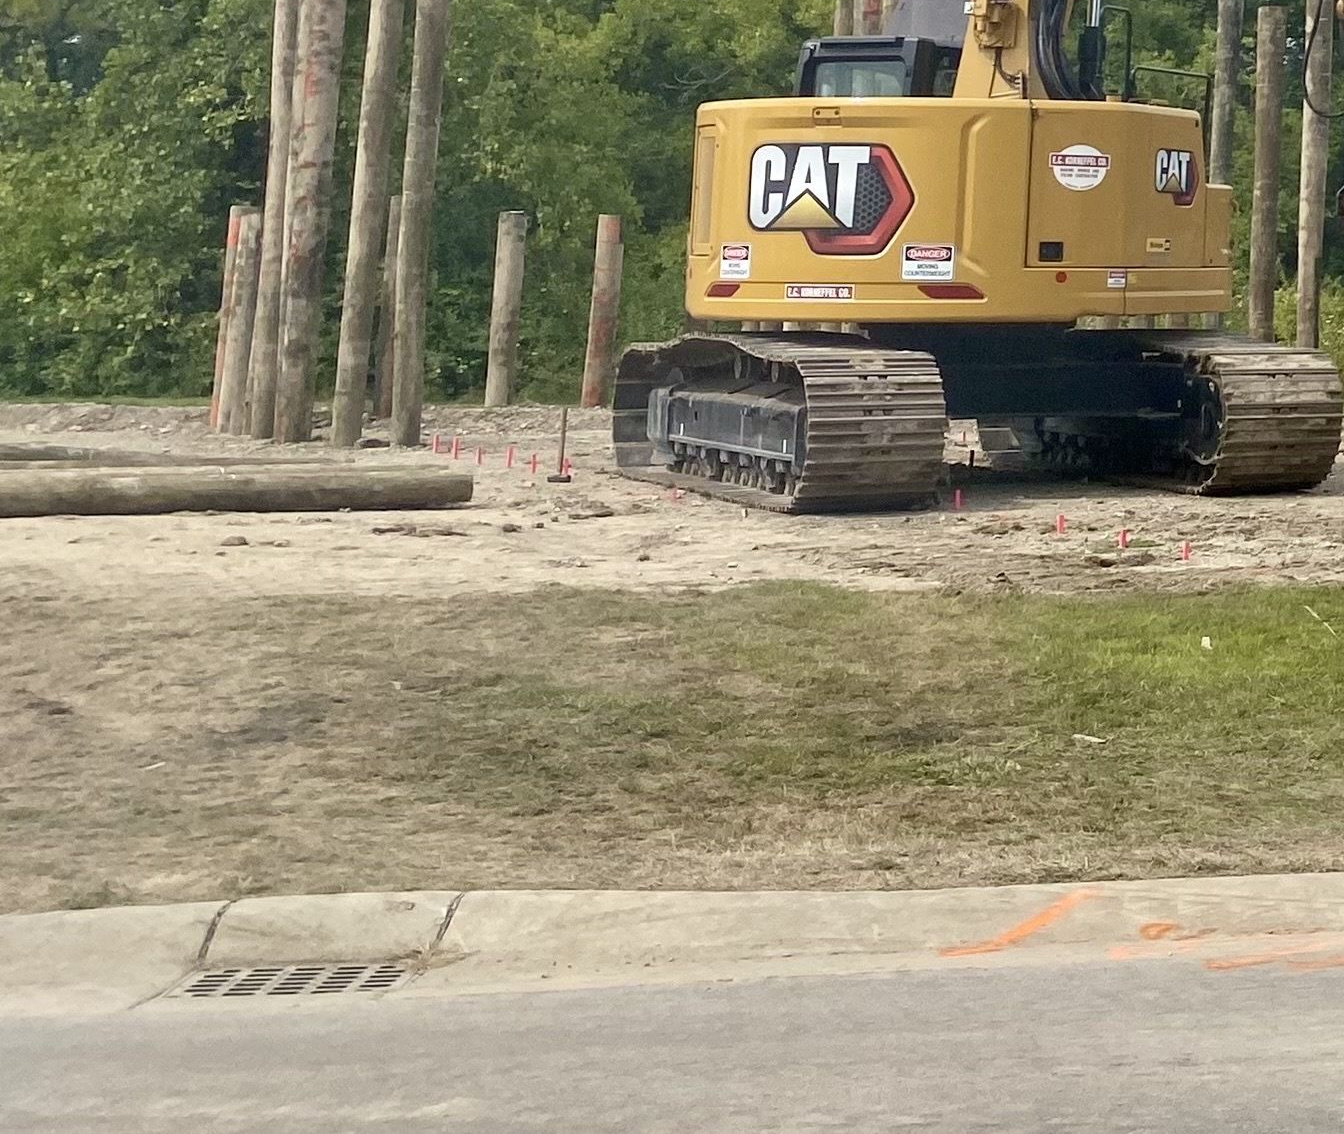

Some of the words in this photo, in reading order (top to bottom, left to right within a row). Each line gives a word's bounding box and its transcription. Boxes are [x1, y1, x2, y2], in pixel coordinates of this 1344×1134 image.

[751, 145, 871, 228] CAT
[1155, 149, 1190, 193] CAT
[909, 248, 947, 258] DANGER
